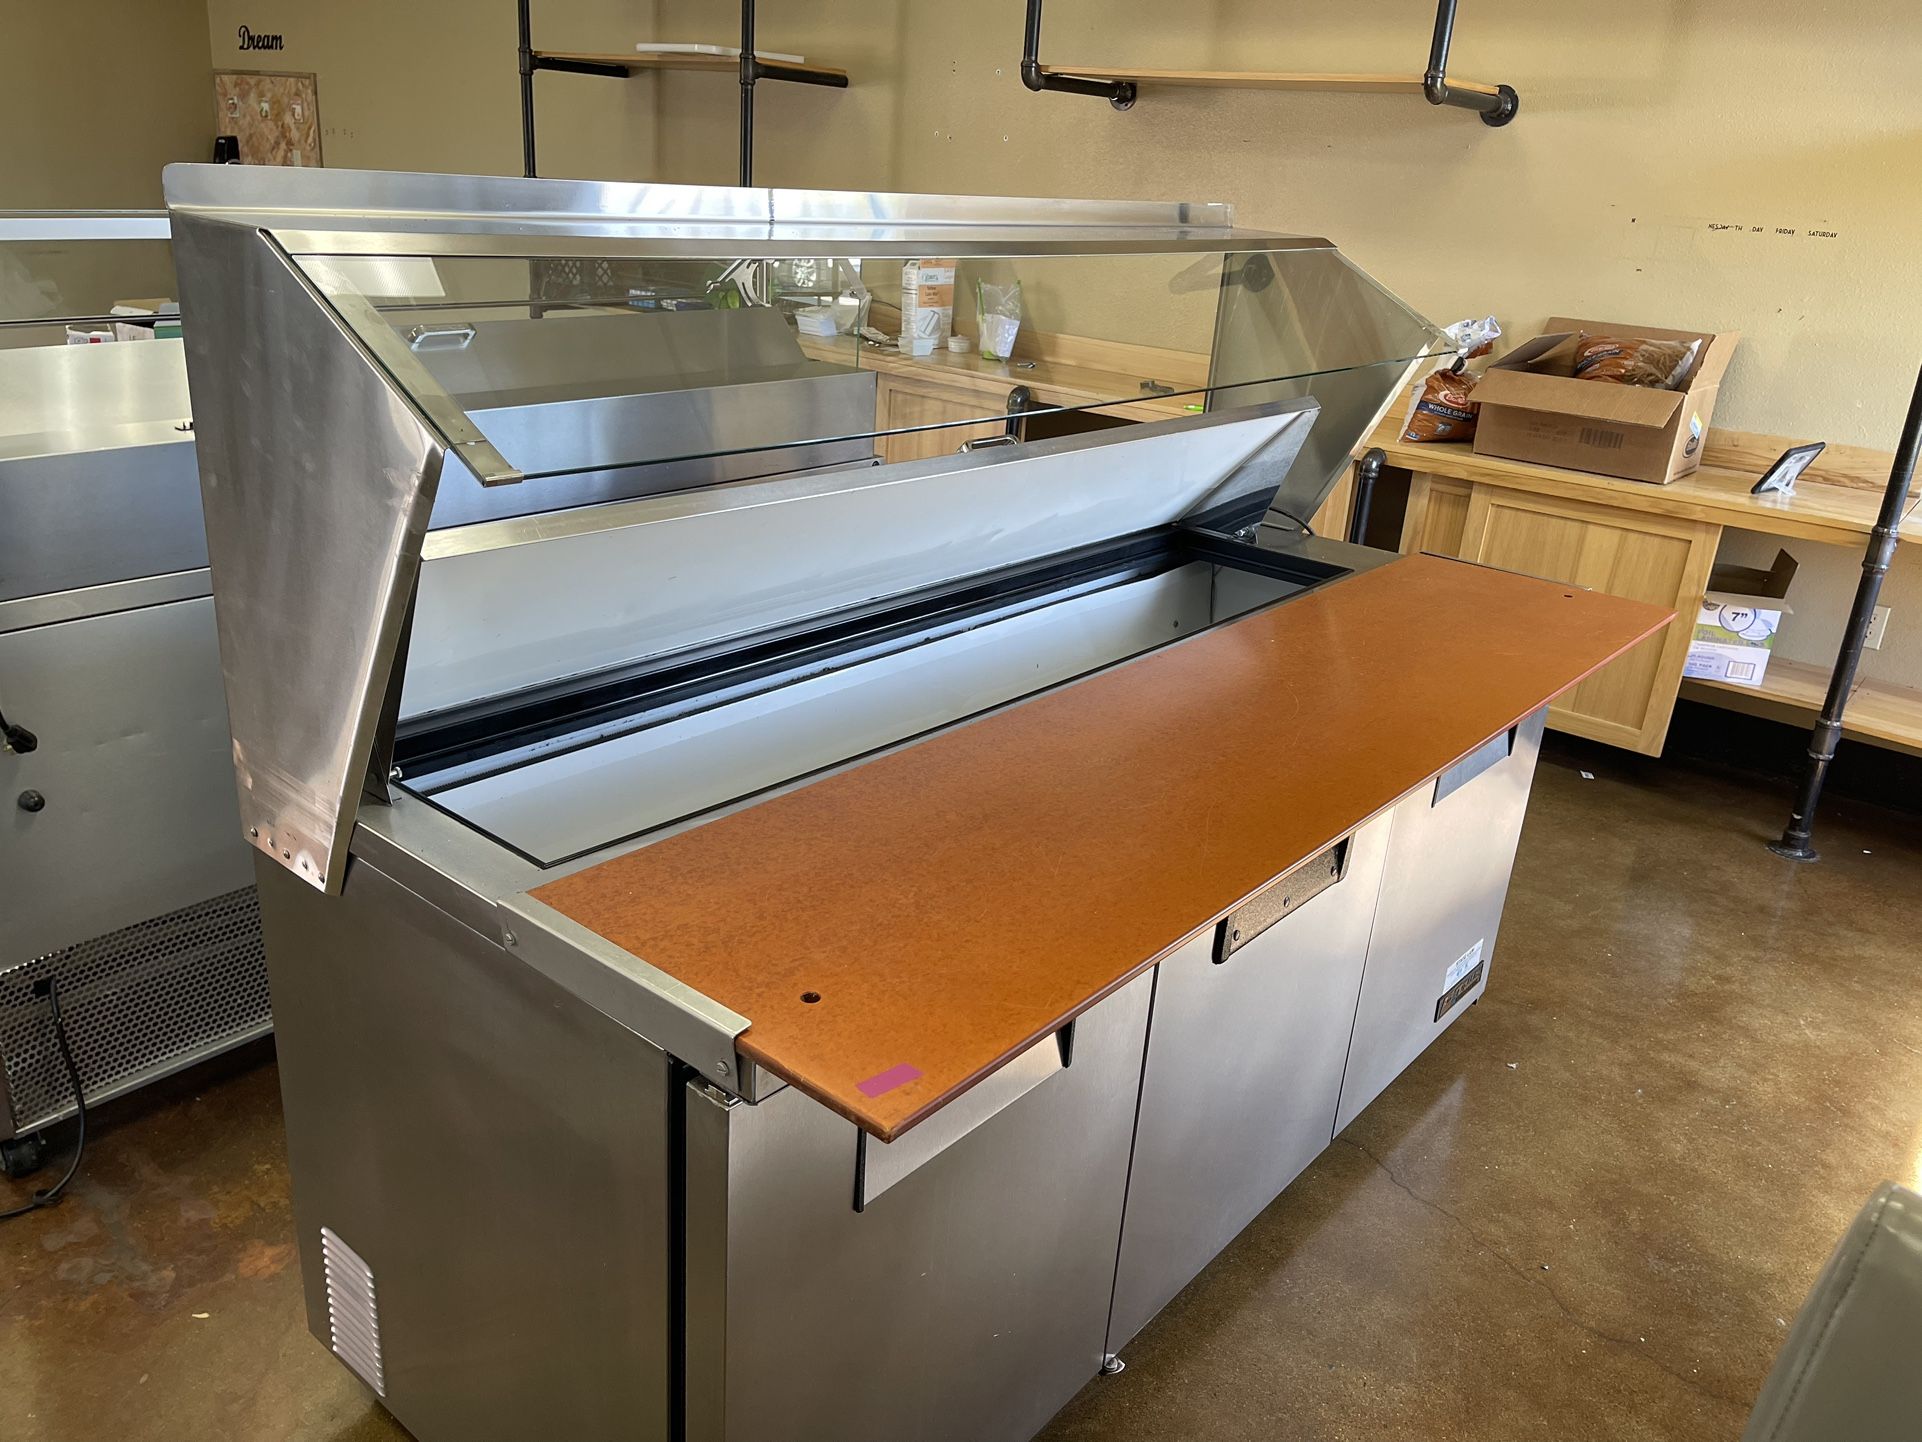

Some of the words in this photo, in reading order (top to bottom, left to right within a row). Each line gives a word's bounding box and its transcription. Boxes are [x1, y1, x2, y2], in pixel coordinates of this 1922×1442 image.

[238, 25, 284, 51] Dream
[1775, 227, 1796, 236] FRIDAY
[1807, 230, 1838, 238] SATURDAY
[1428, 403, 1452, 415] WHOLE
[1452, 409, 1473, 419] GRAIN
